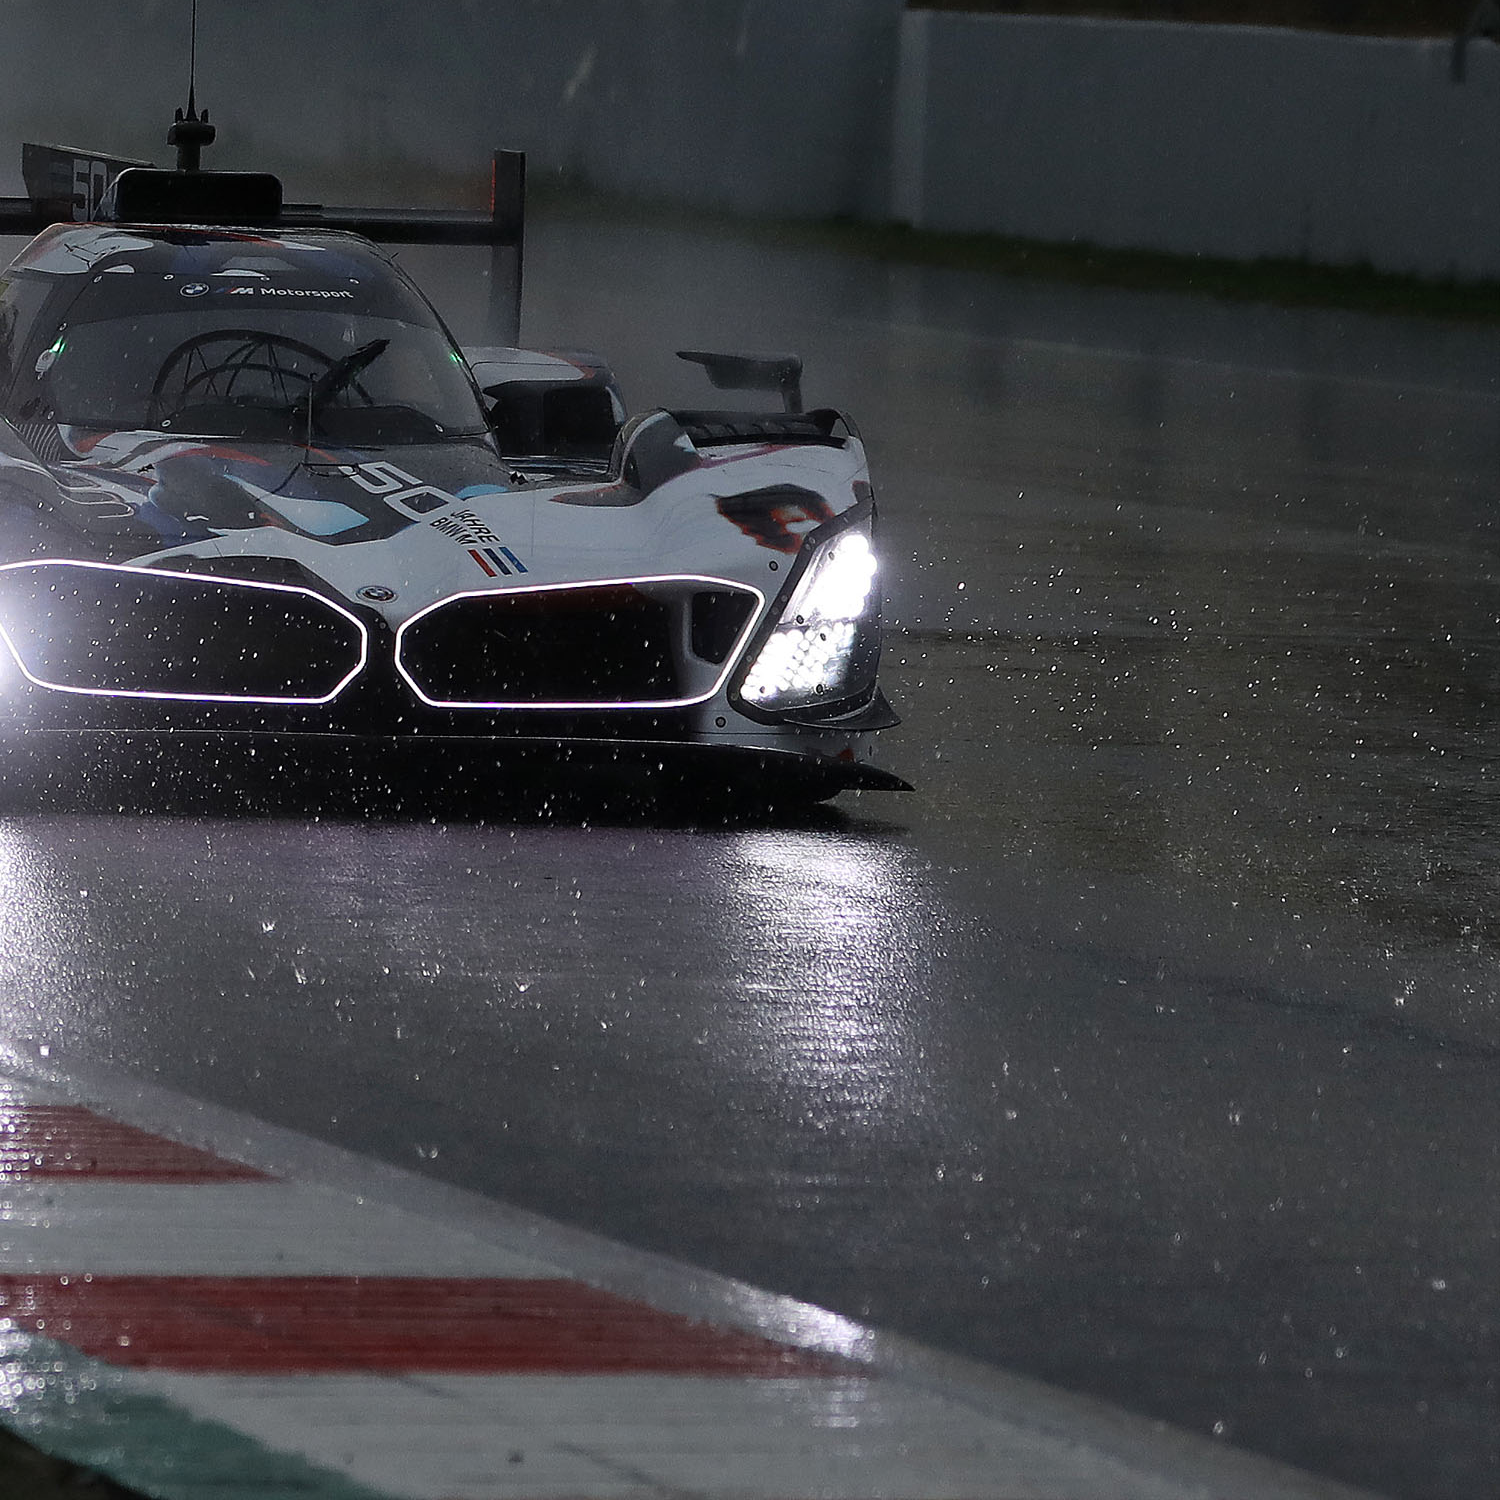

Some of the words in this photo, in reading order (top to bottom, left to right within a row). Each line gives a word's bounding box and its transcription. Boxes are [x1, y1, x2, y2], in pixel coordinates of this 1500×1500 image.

[259, 286, 354, 299] Motorsport
[338, 460, 463, 523] 50
[429, 517, 467, 538] BMW
[455, 534, 478, 545] M
[450, 509, 500, 544] JAHRE
